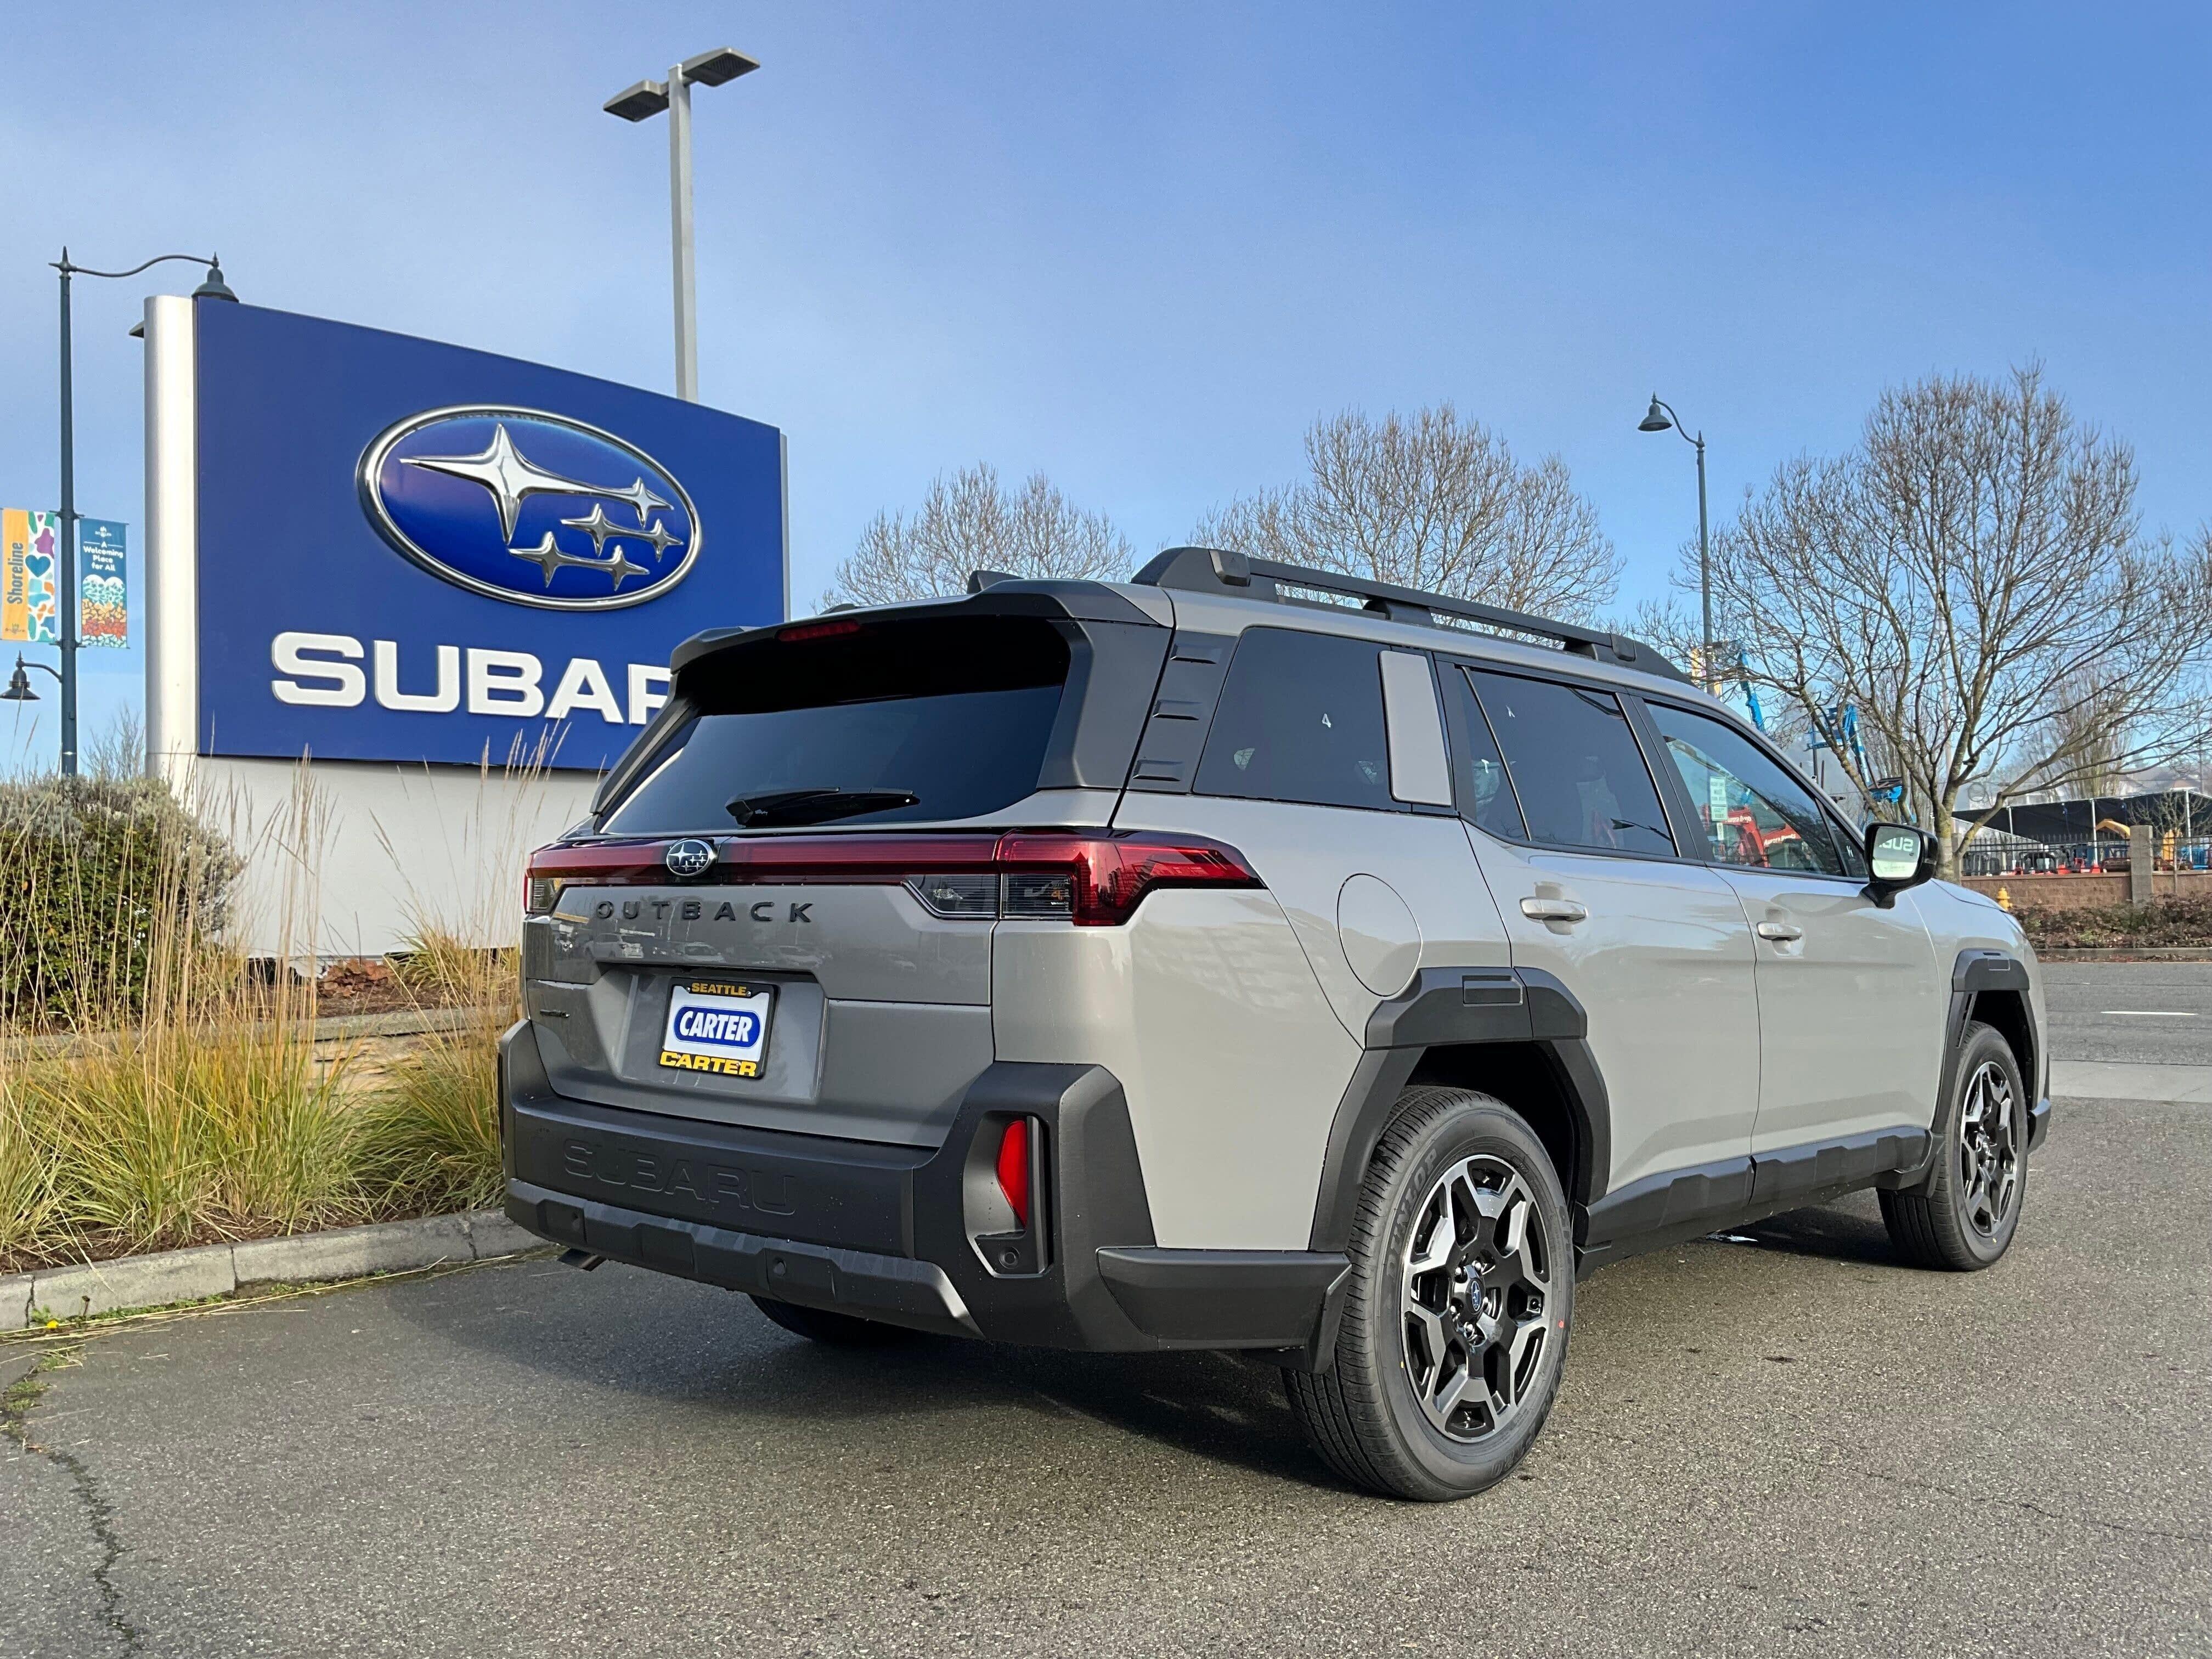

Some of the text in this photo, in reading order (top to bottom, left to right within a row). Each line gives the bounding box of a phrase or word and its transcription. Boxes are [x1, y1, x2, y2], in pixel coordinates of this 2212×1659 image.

[83, 545, 123, 558] Welcoming
[93, 554, 113, 563] Place
[7, 542, 24, 604] Shoreline
[91, 562, 103, 570] for
[596, 900, 814, 923] OUTBACK
[691, 983, 747, 996] SEATTLE
[679, 1011, 753, 1042] CARTER
[660, 1051, 757, 1077] CARTER
[565, 1138, 795, 1216] SUBARU
[1386, 1148, 1437, 1280] DUNLOP
